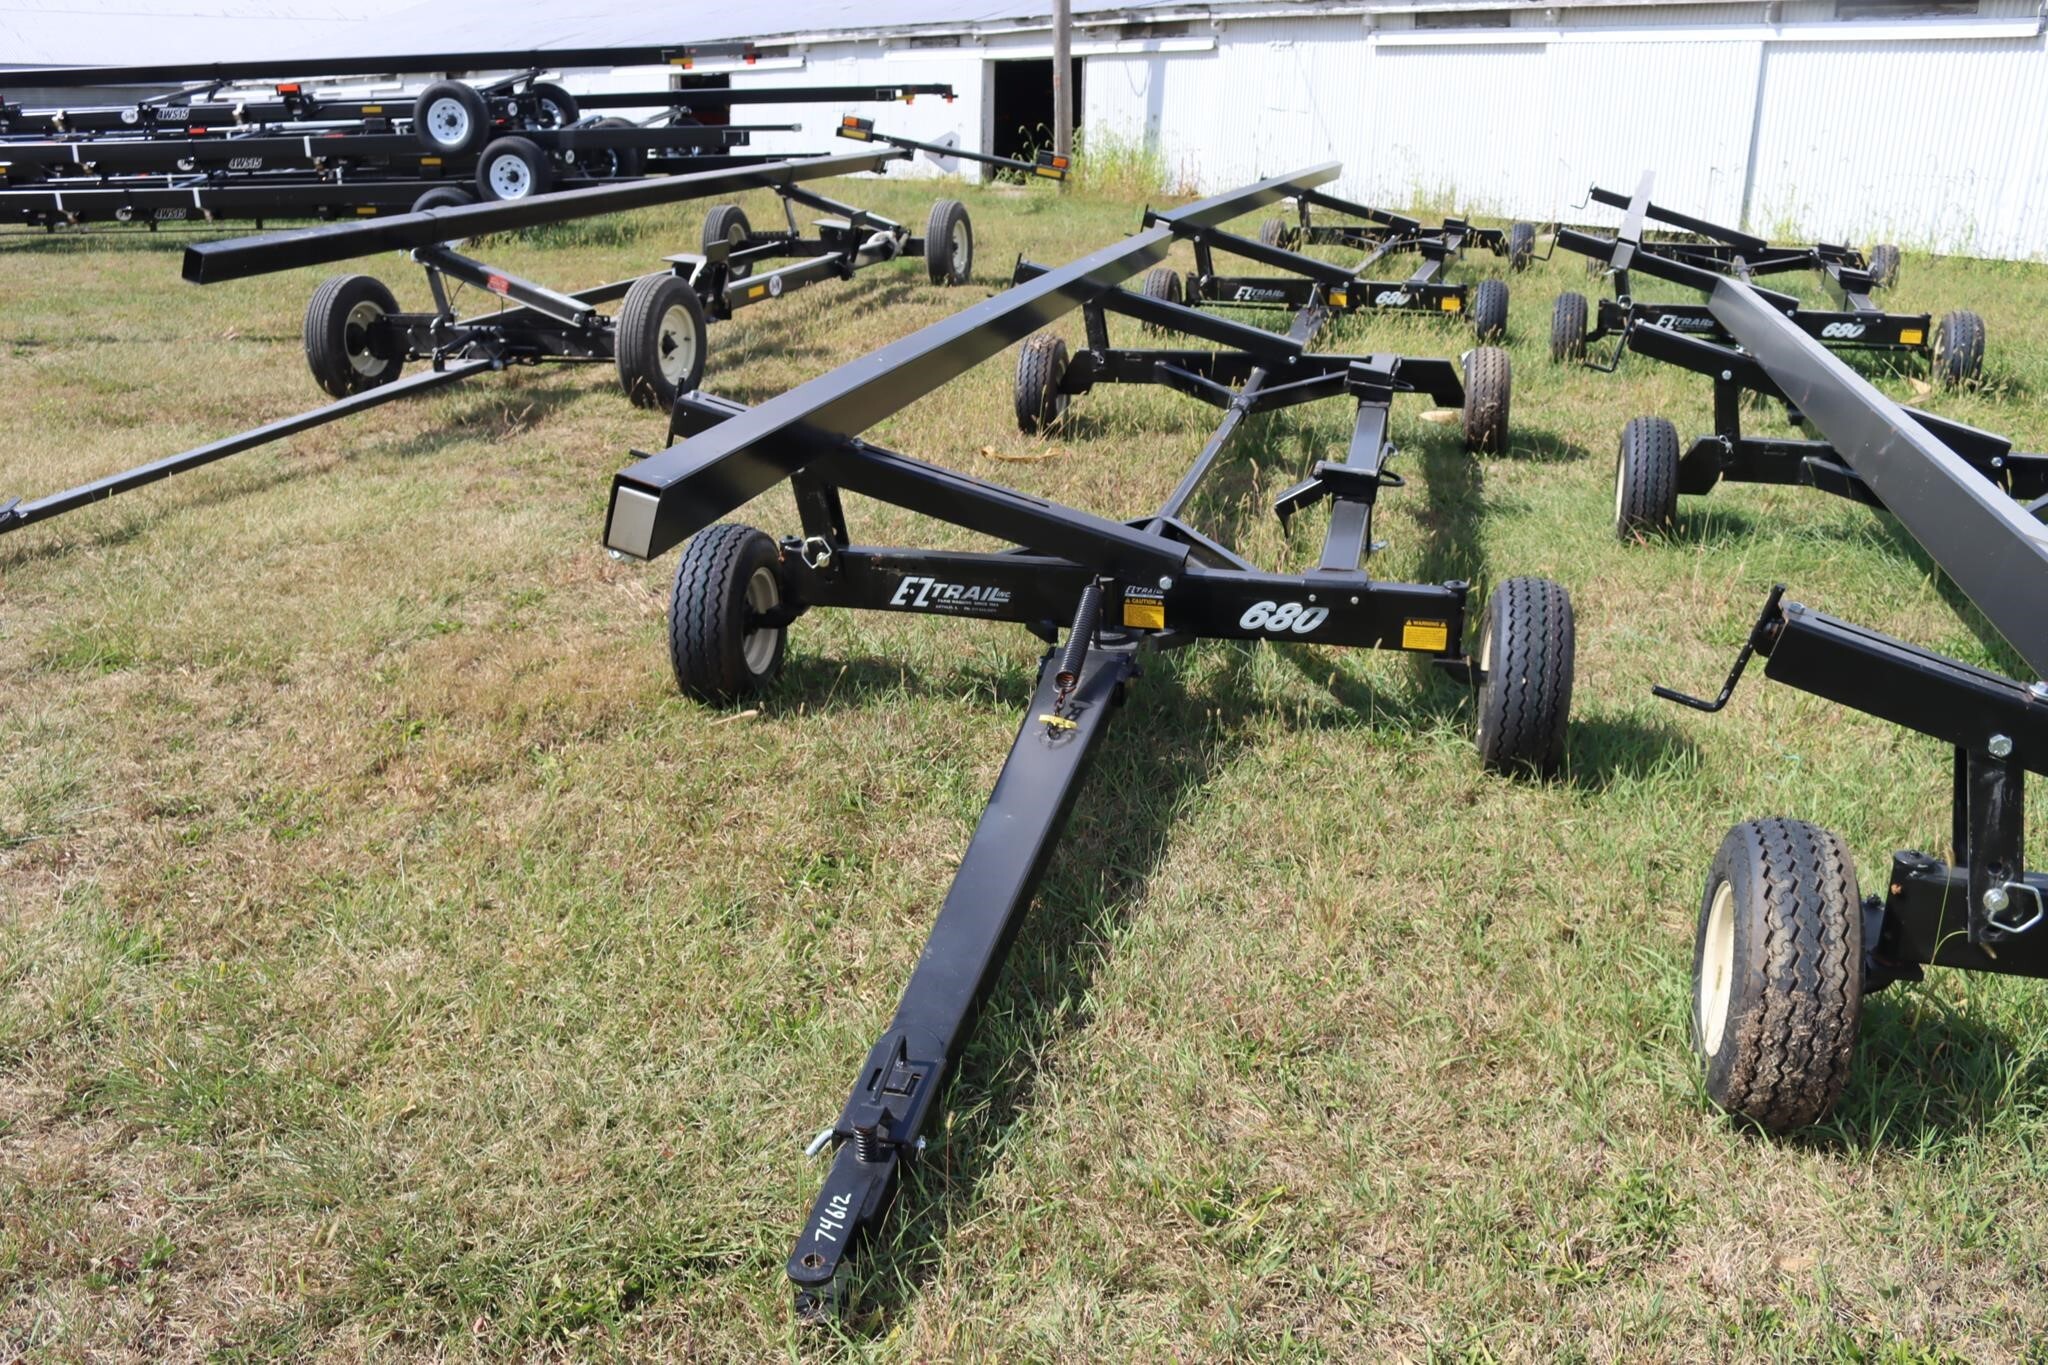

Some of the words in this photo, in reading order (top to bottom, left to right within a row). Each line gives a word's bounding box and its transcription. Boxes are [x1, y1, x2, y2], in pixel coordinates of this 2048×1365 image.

[1822, 322, 1866, 338] 680
[931, 583, 1009, 602] TRAIL
[1239, 600, 1329, 634] 680
[815, 1193, 852, 1242] 74612
